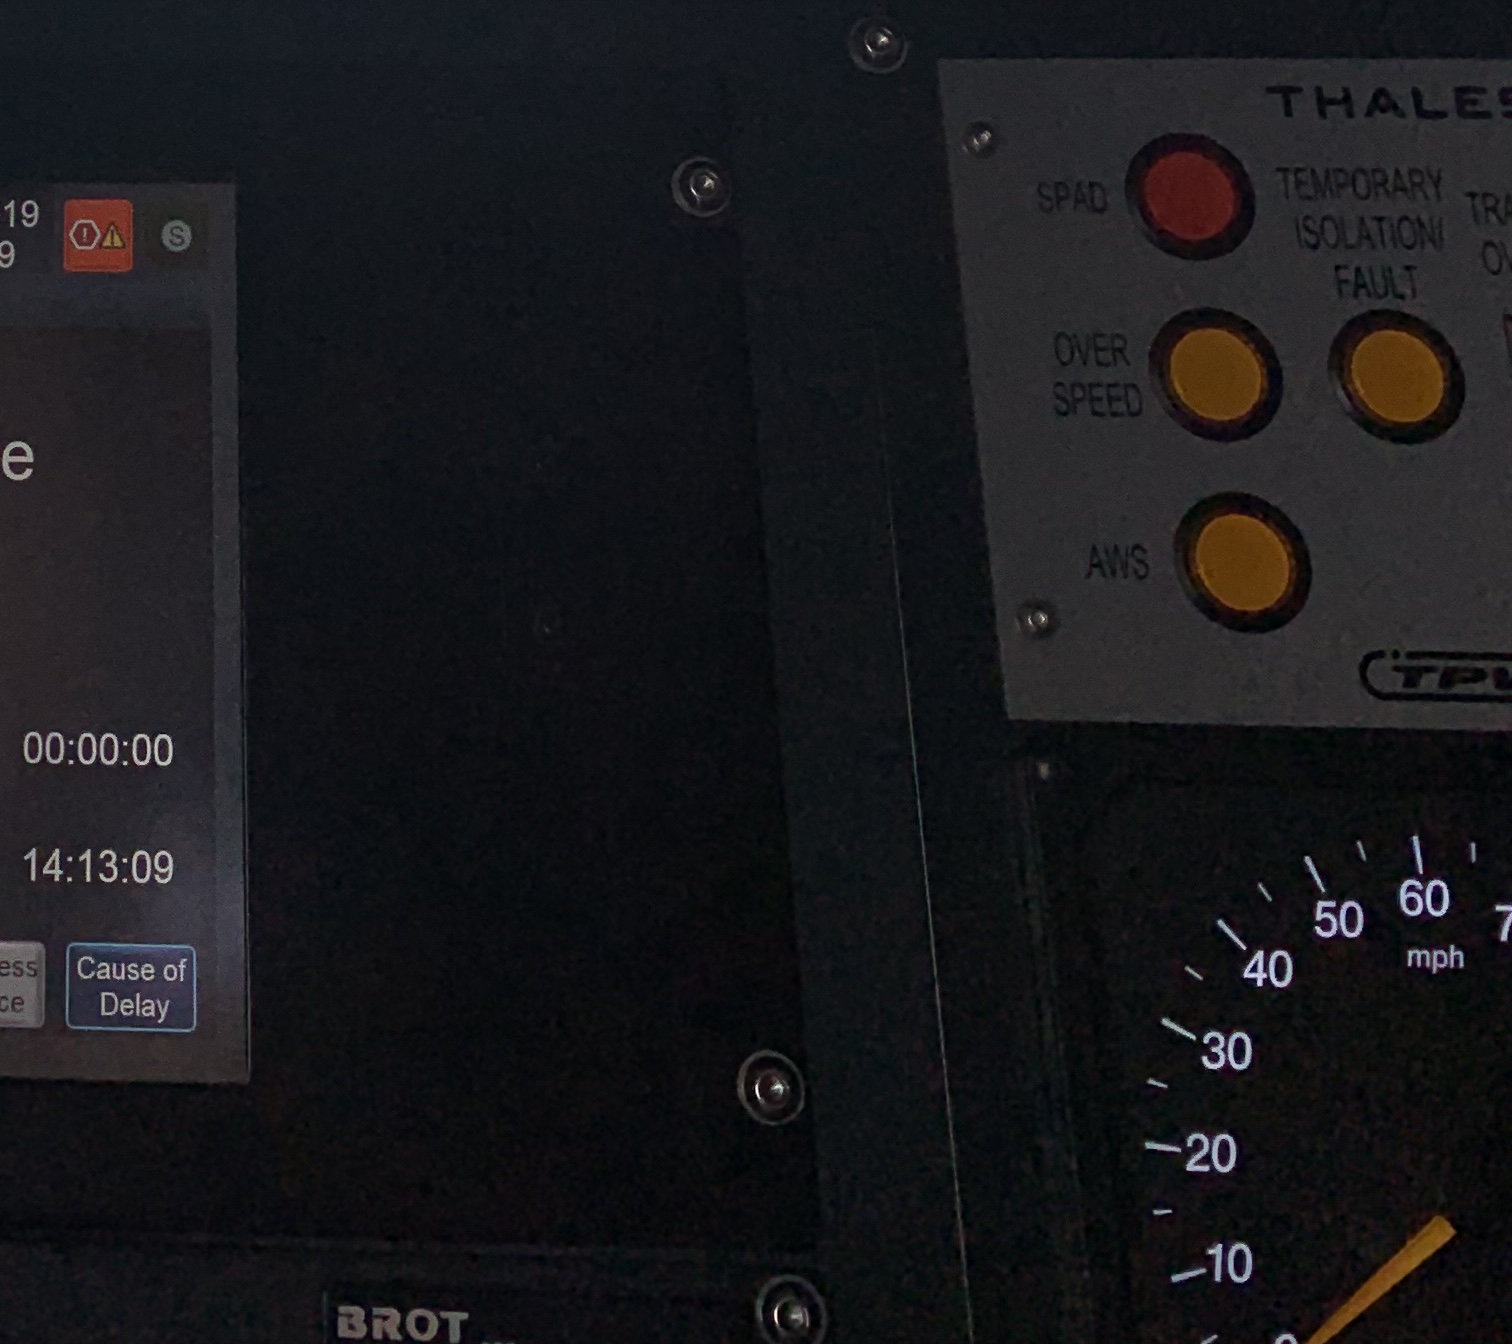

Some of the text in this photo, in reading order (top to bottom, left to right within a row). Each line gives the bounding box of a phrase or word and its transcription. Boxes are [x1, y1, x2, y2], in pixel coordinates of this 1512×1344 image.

[1036, 180, 1109, 215] SPAD
[1274, 166, 1443, 202] TEMPORARY
[1333, 263, 1418, 301] FAULT
[1053, 331, 1131, 368] OVER
[1053, 381, 1143, 419] SPEED
[1085, 542, 1150, 582] AWS
[23, 731, 174, 767] 00:00:00
[23, 847, 174, 885] 14:13:09
[1399, 878, 1450, 918] 60
[1314, 900, 1365, 939] 50
[77, 955, 188, 983] Cause of
[1242, 949, 1293, 989] 40
[1407, 944, 1465, 974] mph
[100, 991, 171, 1025] Delay
[1201, 1030, 1253, 1071] 30
[1185, 1132, 1237, 1174] 20
[1207, 1242, 1253, 1284] 10
[337, 1305, 470, 1344] BROT
